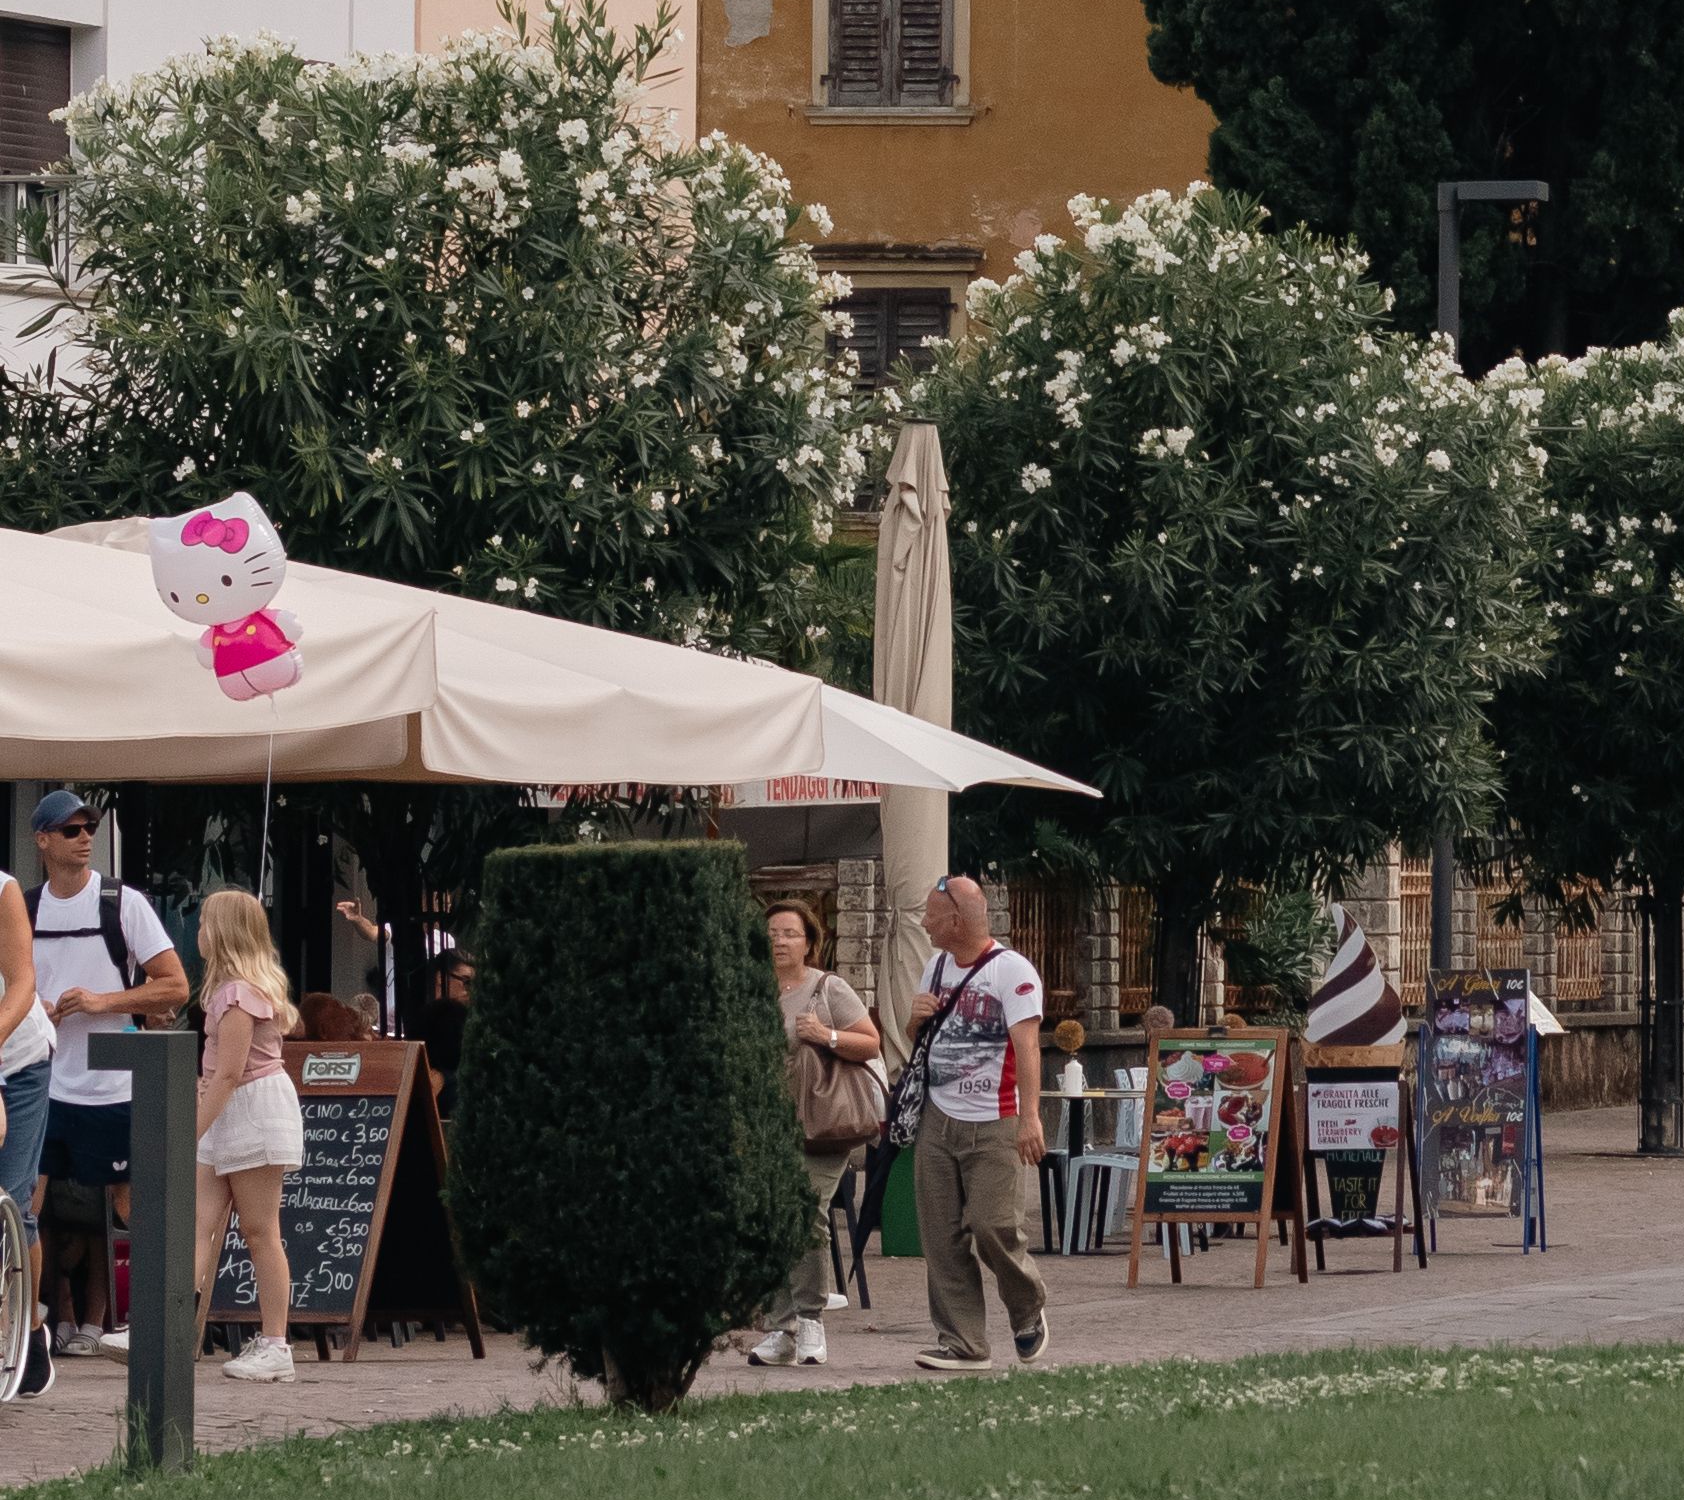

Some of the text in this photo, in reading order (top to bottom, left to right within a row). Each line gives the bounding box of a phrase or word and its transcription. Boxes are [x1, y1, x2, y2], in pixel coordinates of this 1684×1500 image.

[307, 1061, 357, 1076] FORST
[958, 1078, 991, 1094] 1959
[1323, 1088, 1379, 1099] GRANITA ALLE
[1317, 1098, 1389, 1108] FRAGOLE FRESCHE
[1317, 1120, 1338, 1128] FRESH
[1317, 1128, 1362, 1136] STRAWBERRY
[1317, 1136, 1348, 1145] GRANITA
[1332, 1177, 1378, 1192] TASTE IT
[1344, 1192, 1367, 1209] FOR
[295, 1221, 314, 1234] 0,5
